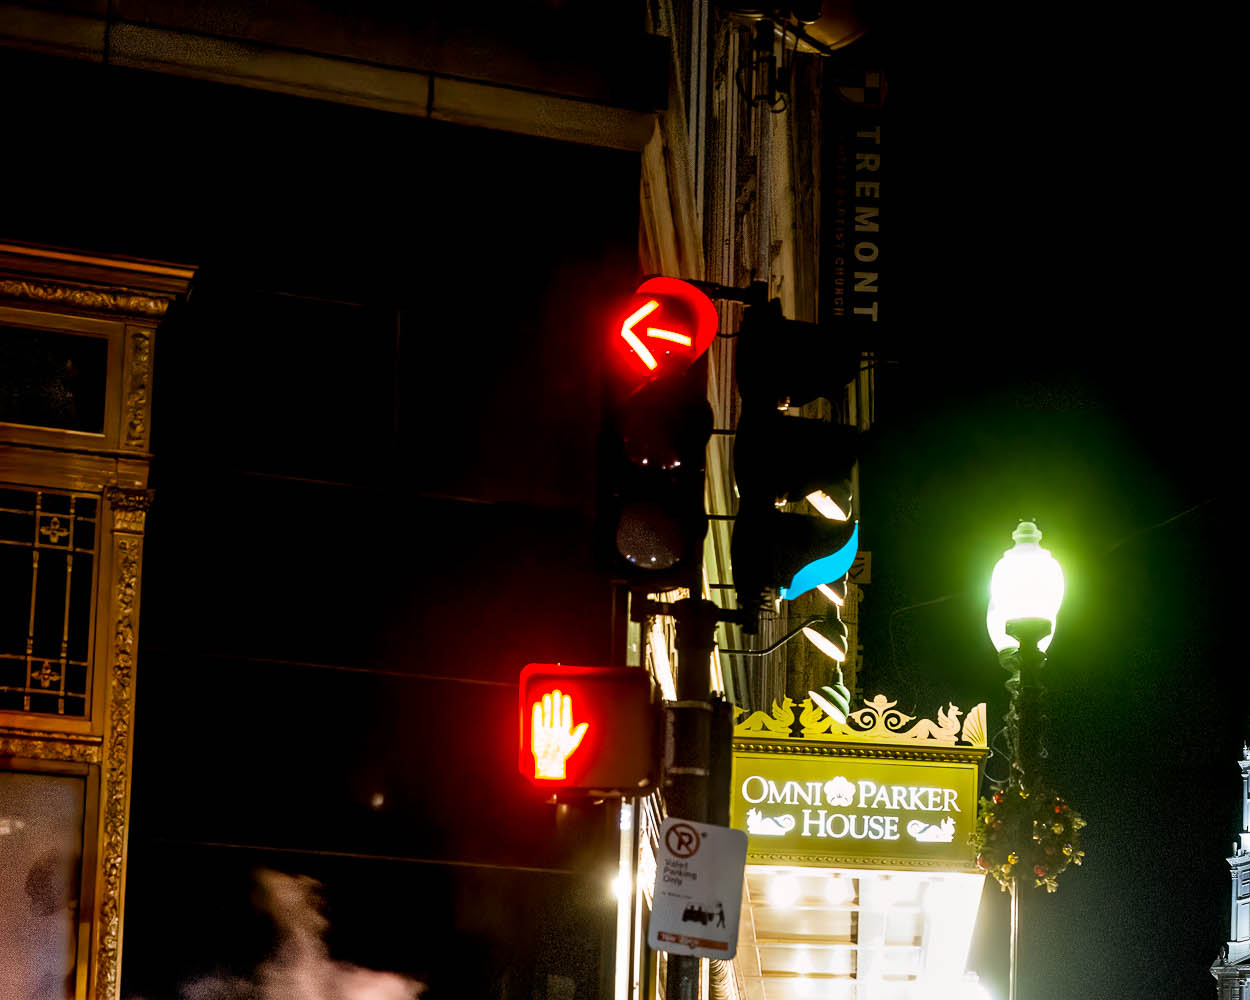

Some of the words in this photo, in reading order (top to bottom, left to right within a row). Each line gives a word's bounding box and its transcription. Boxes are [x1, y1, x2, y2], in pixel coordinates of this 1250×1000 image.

[853, 125, 881, 323] TREMONT
[741, 775, 823, 806] OMNI
[857, 780, 962, 812] PARKER
[801, 809, 901, 841] HOUSE
